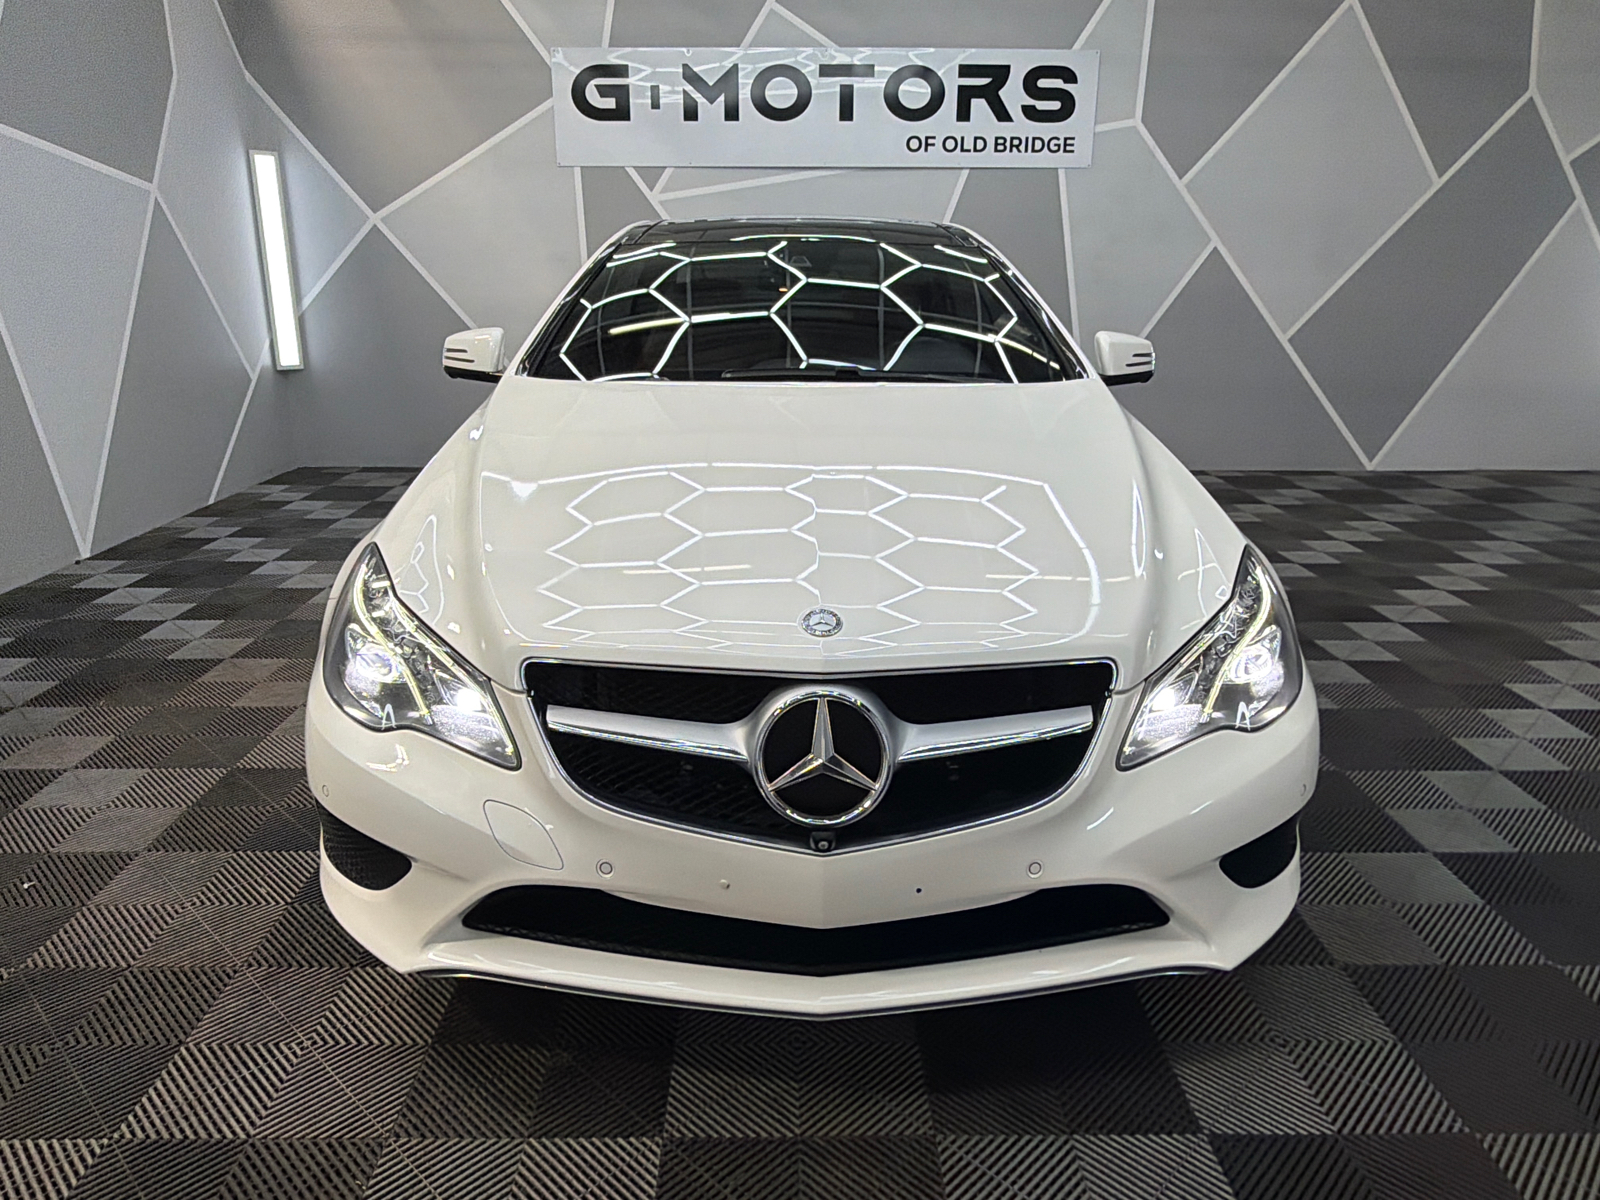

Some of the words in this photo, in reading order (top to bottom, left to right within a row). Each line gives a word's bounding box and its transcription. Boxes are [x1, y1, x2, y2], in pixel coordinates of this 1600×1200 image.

[905, 135, 937, 153] OF
[942, 135, 988, 153] OLD
[993, 136, 1076, 154] BRIDGE
